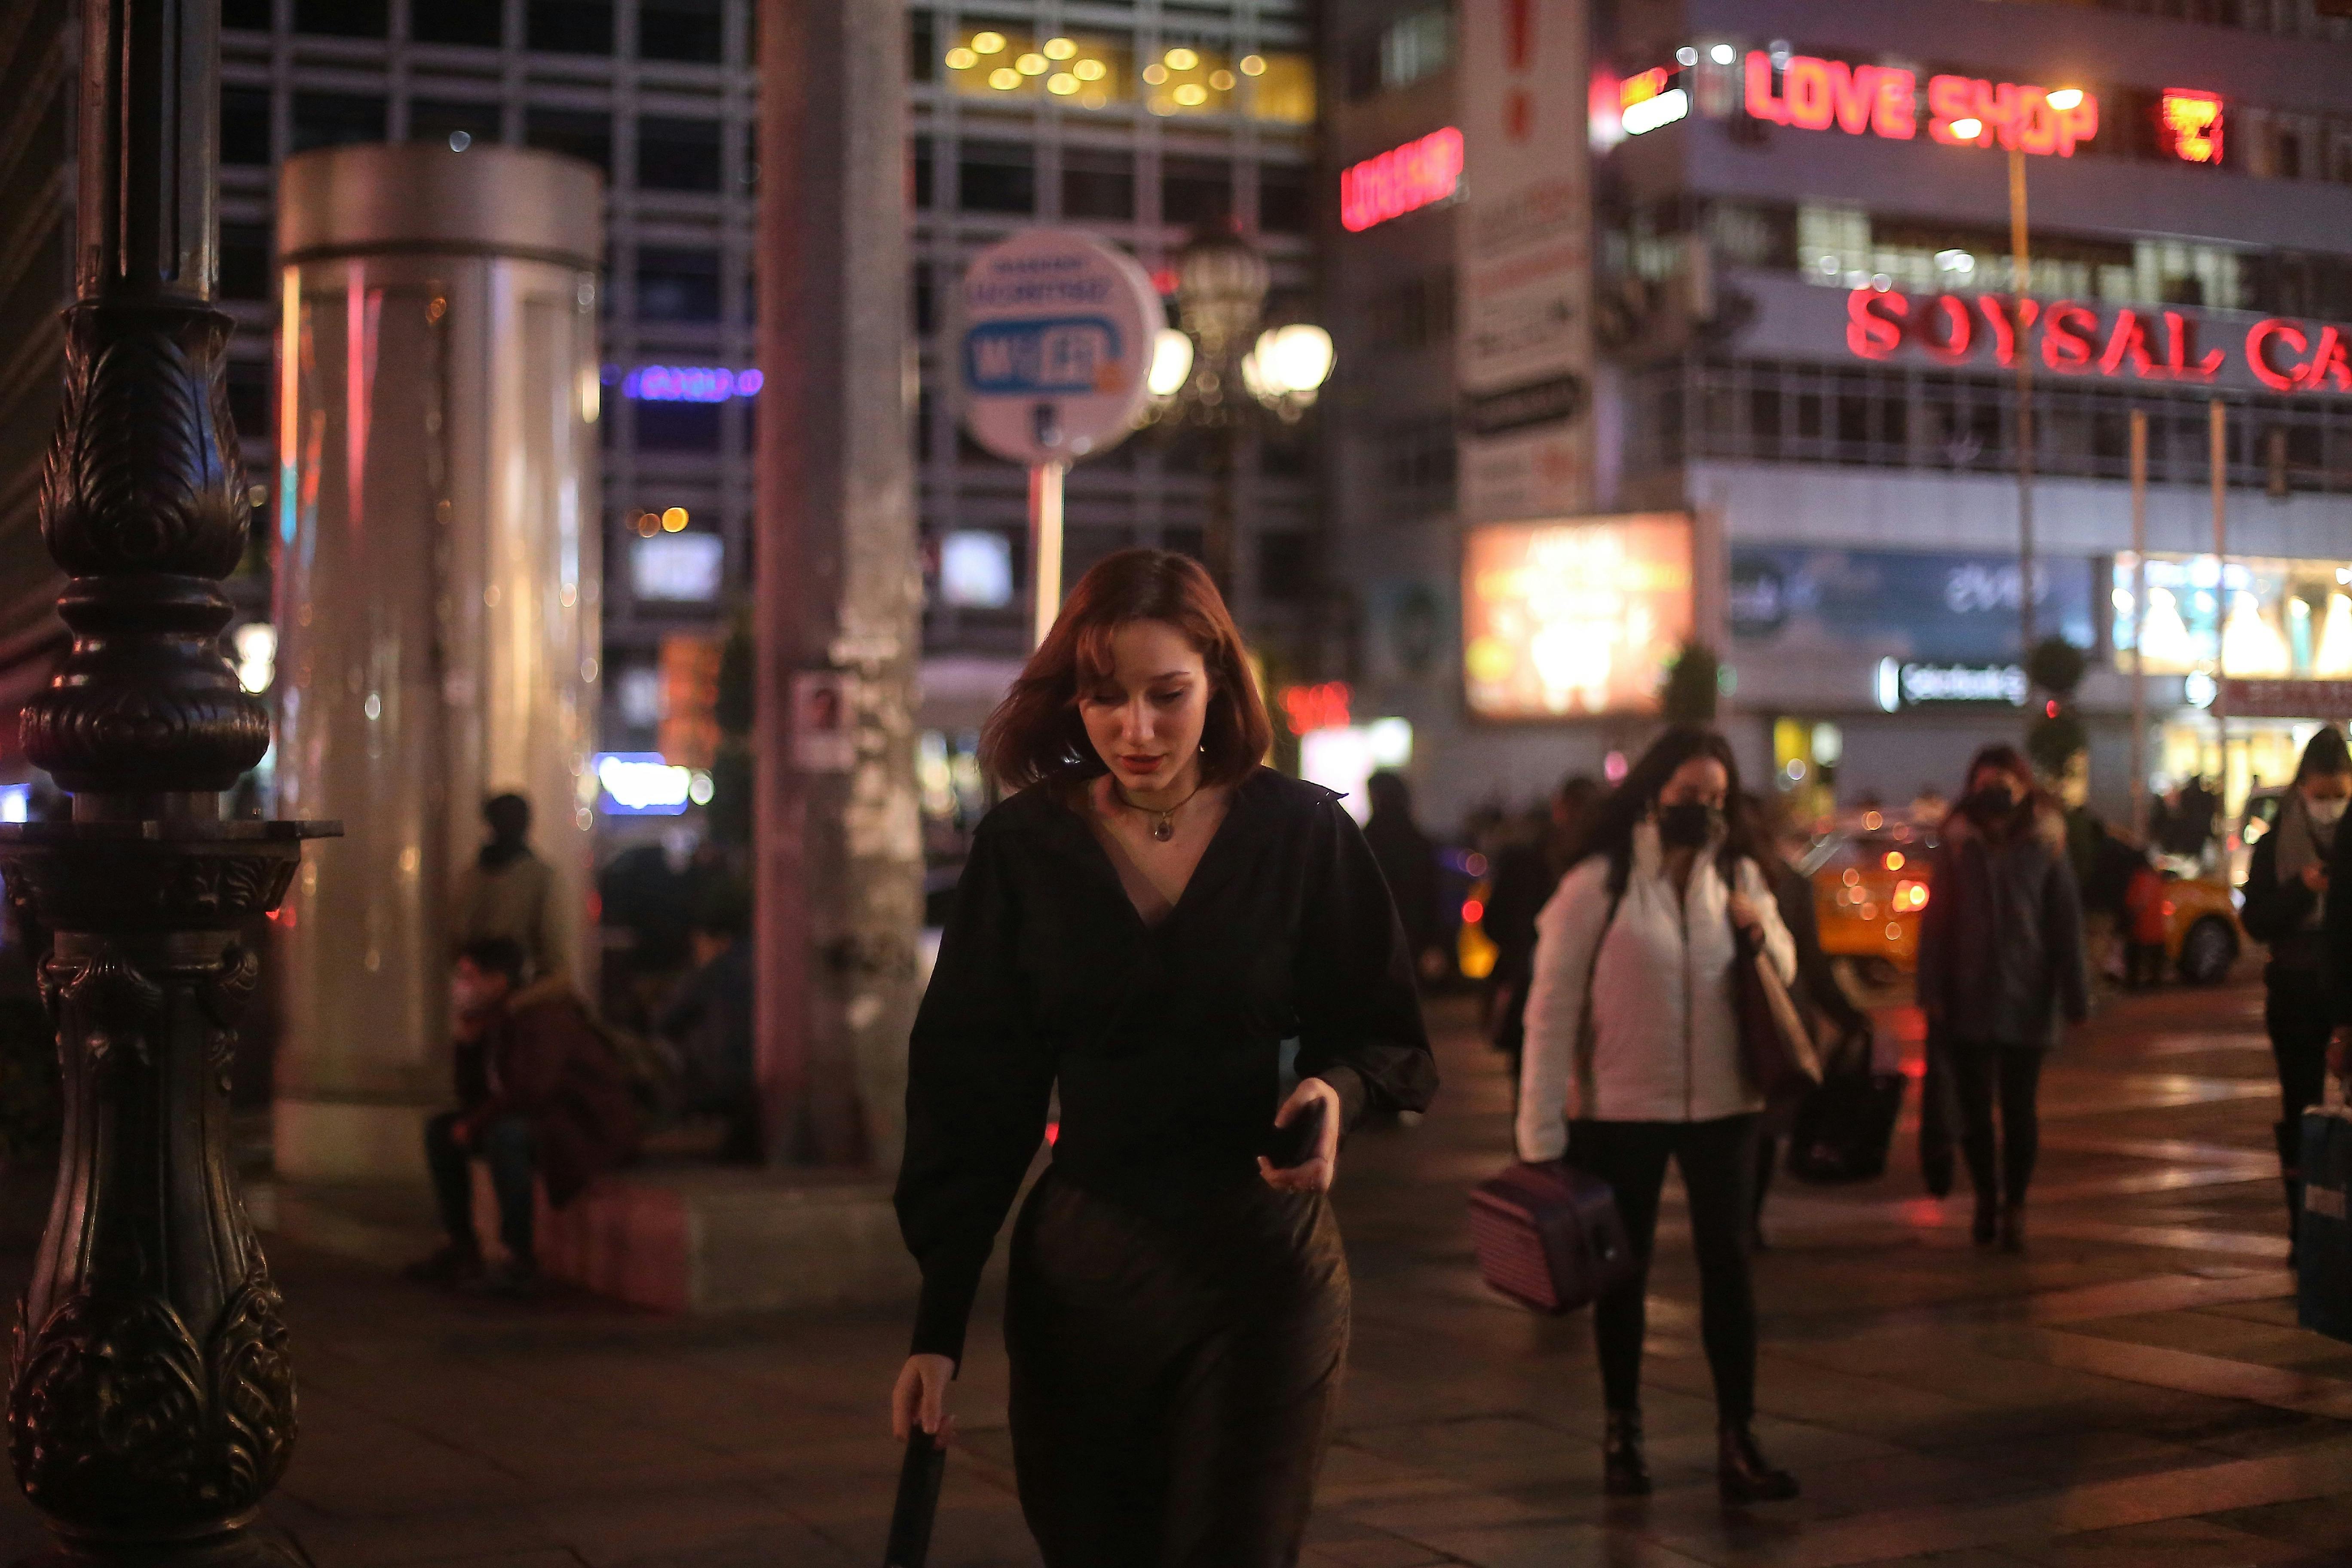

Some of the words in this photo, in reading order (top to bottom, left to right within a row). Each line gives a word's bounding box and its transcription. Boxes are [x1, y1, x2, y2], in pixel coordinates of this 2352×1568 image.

[1745, 50, 1917, 141] LOVE
[1929, 74, 2098, 158] SHOP
[1847, 287, 2226, 383] SOYSAL
